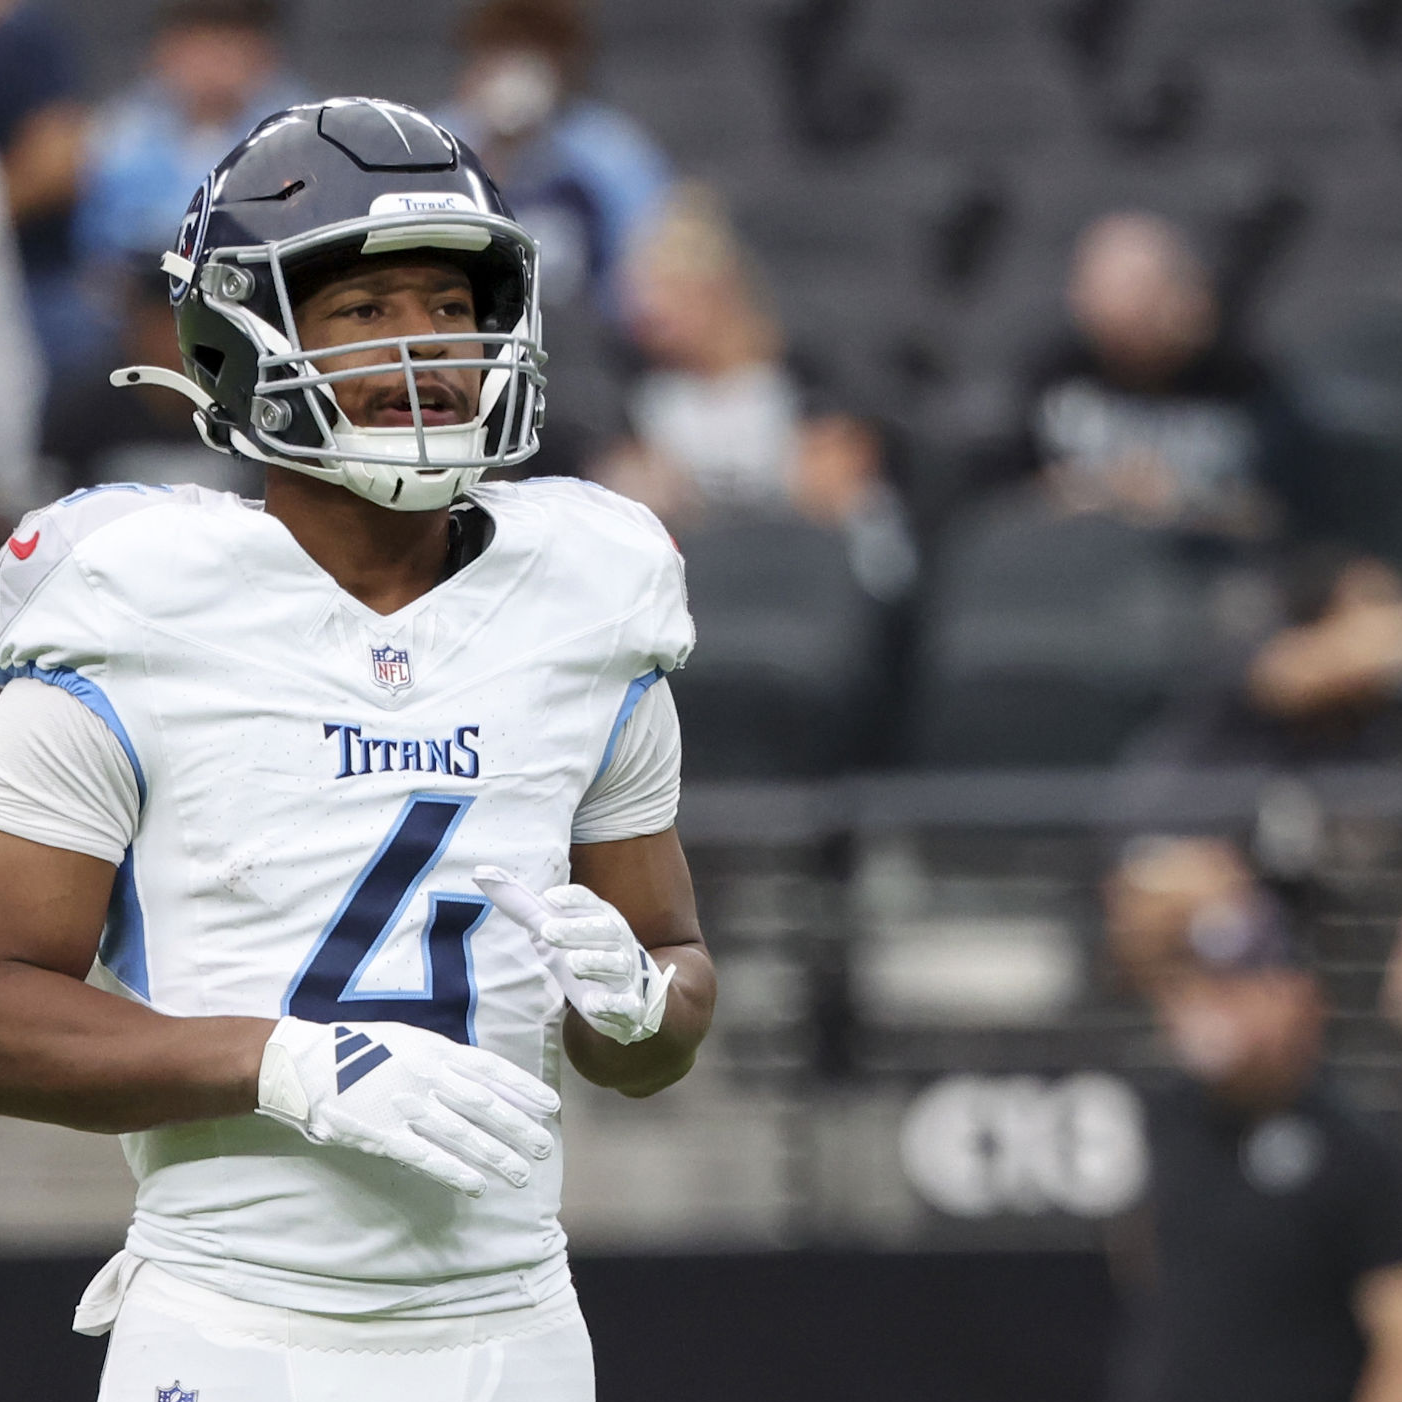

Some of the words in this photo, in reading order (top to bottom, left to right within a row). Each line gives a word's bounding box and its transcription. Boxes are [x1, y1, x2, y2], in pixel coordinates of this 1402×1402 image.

[377, 662, 407, 683] NFL
[323, 722, 480, 780] TITANS
[281, 792, 496, 1047] 4
